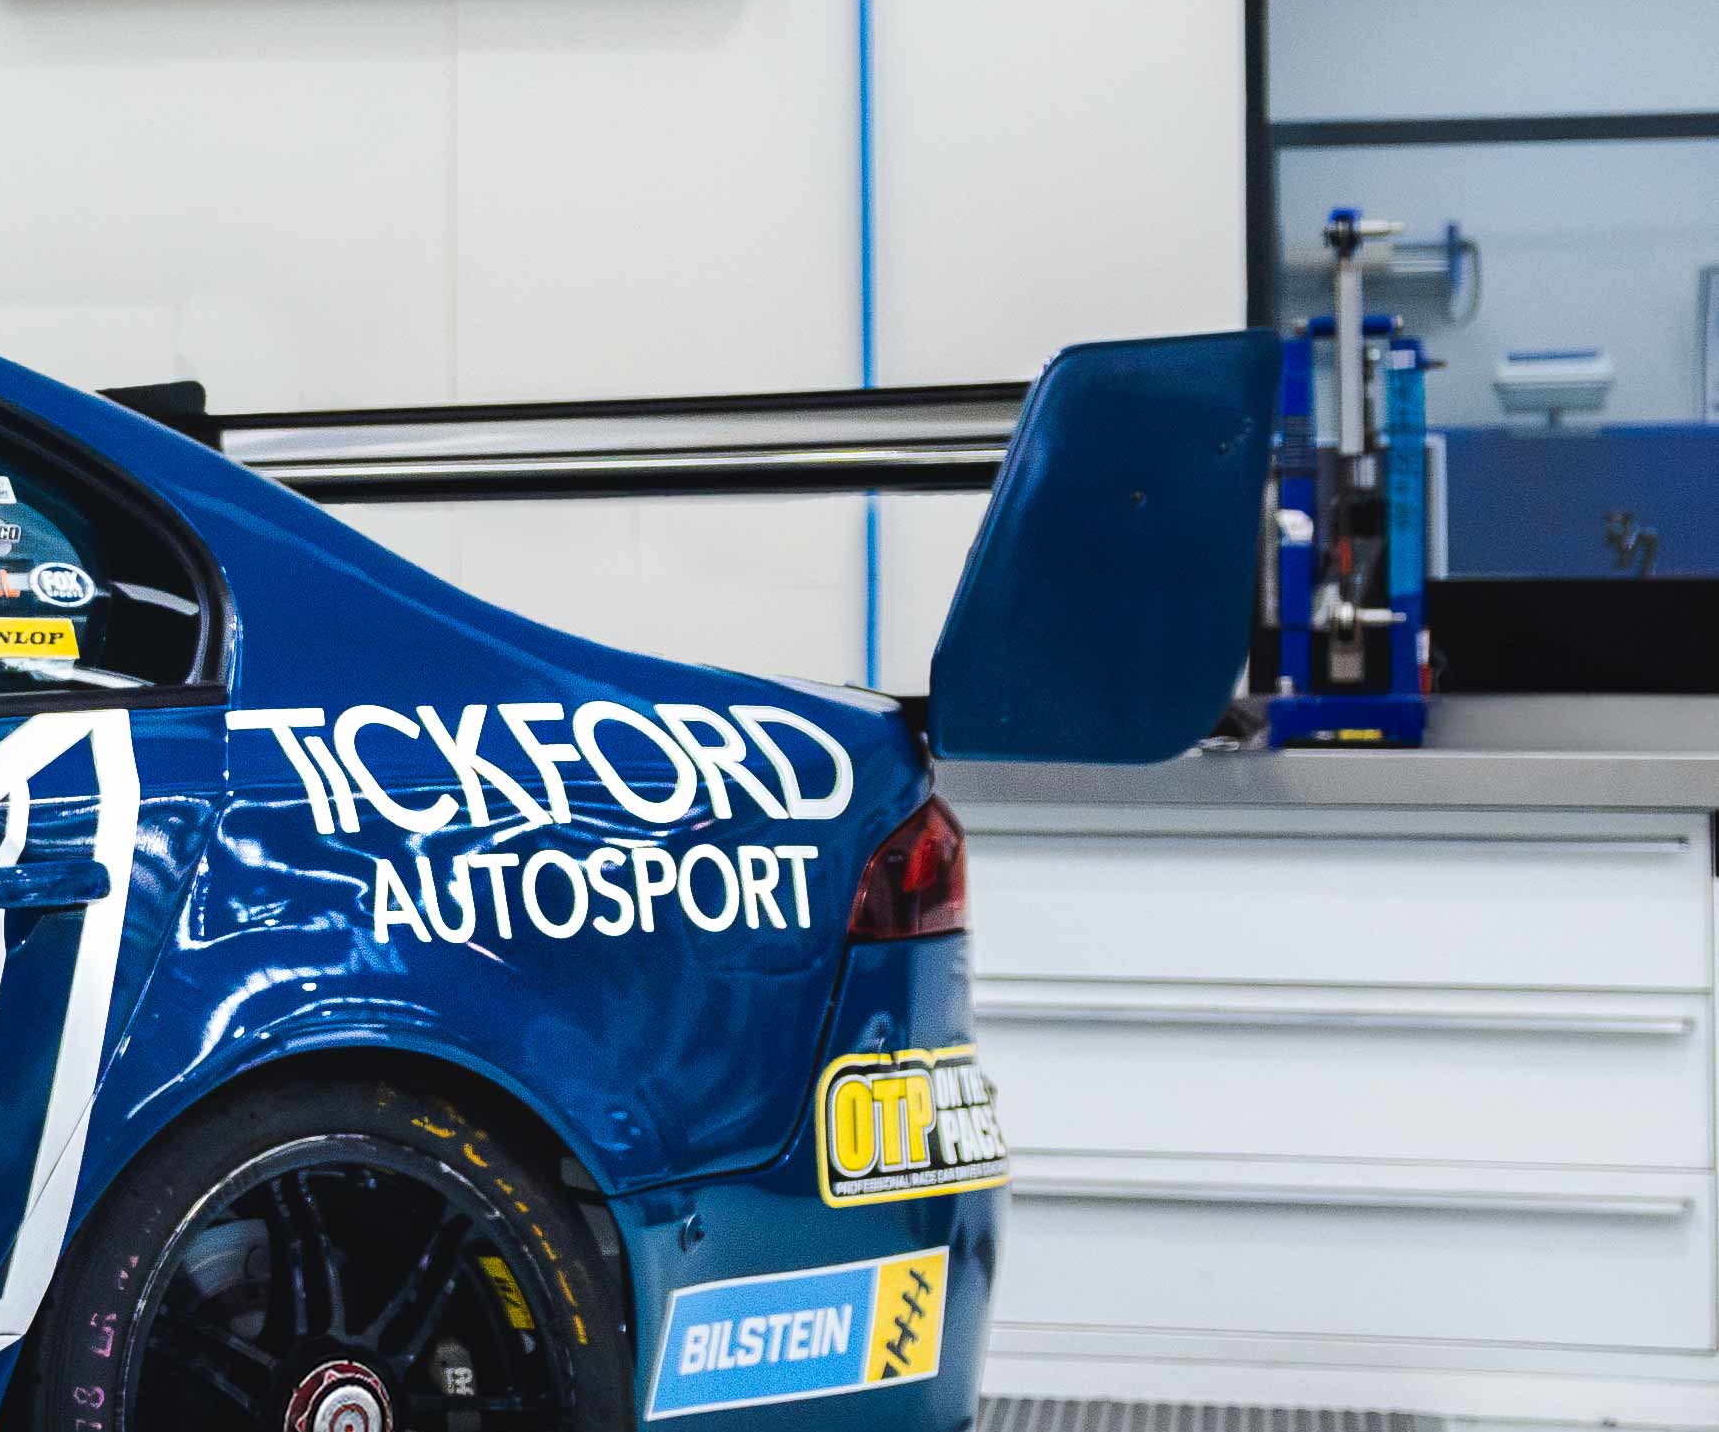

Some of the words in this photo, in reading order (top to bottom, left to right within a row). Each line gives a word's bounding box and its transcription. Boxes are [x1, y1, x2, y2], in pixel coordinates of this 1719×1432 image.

[225, 700, 855, 835] TICKFORD
[374, 843, 819, 944] AUTOSPORT
[833, 1073, 934, 1173] OTP
[680, 1304, 853, 1376] BILSTEIN
